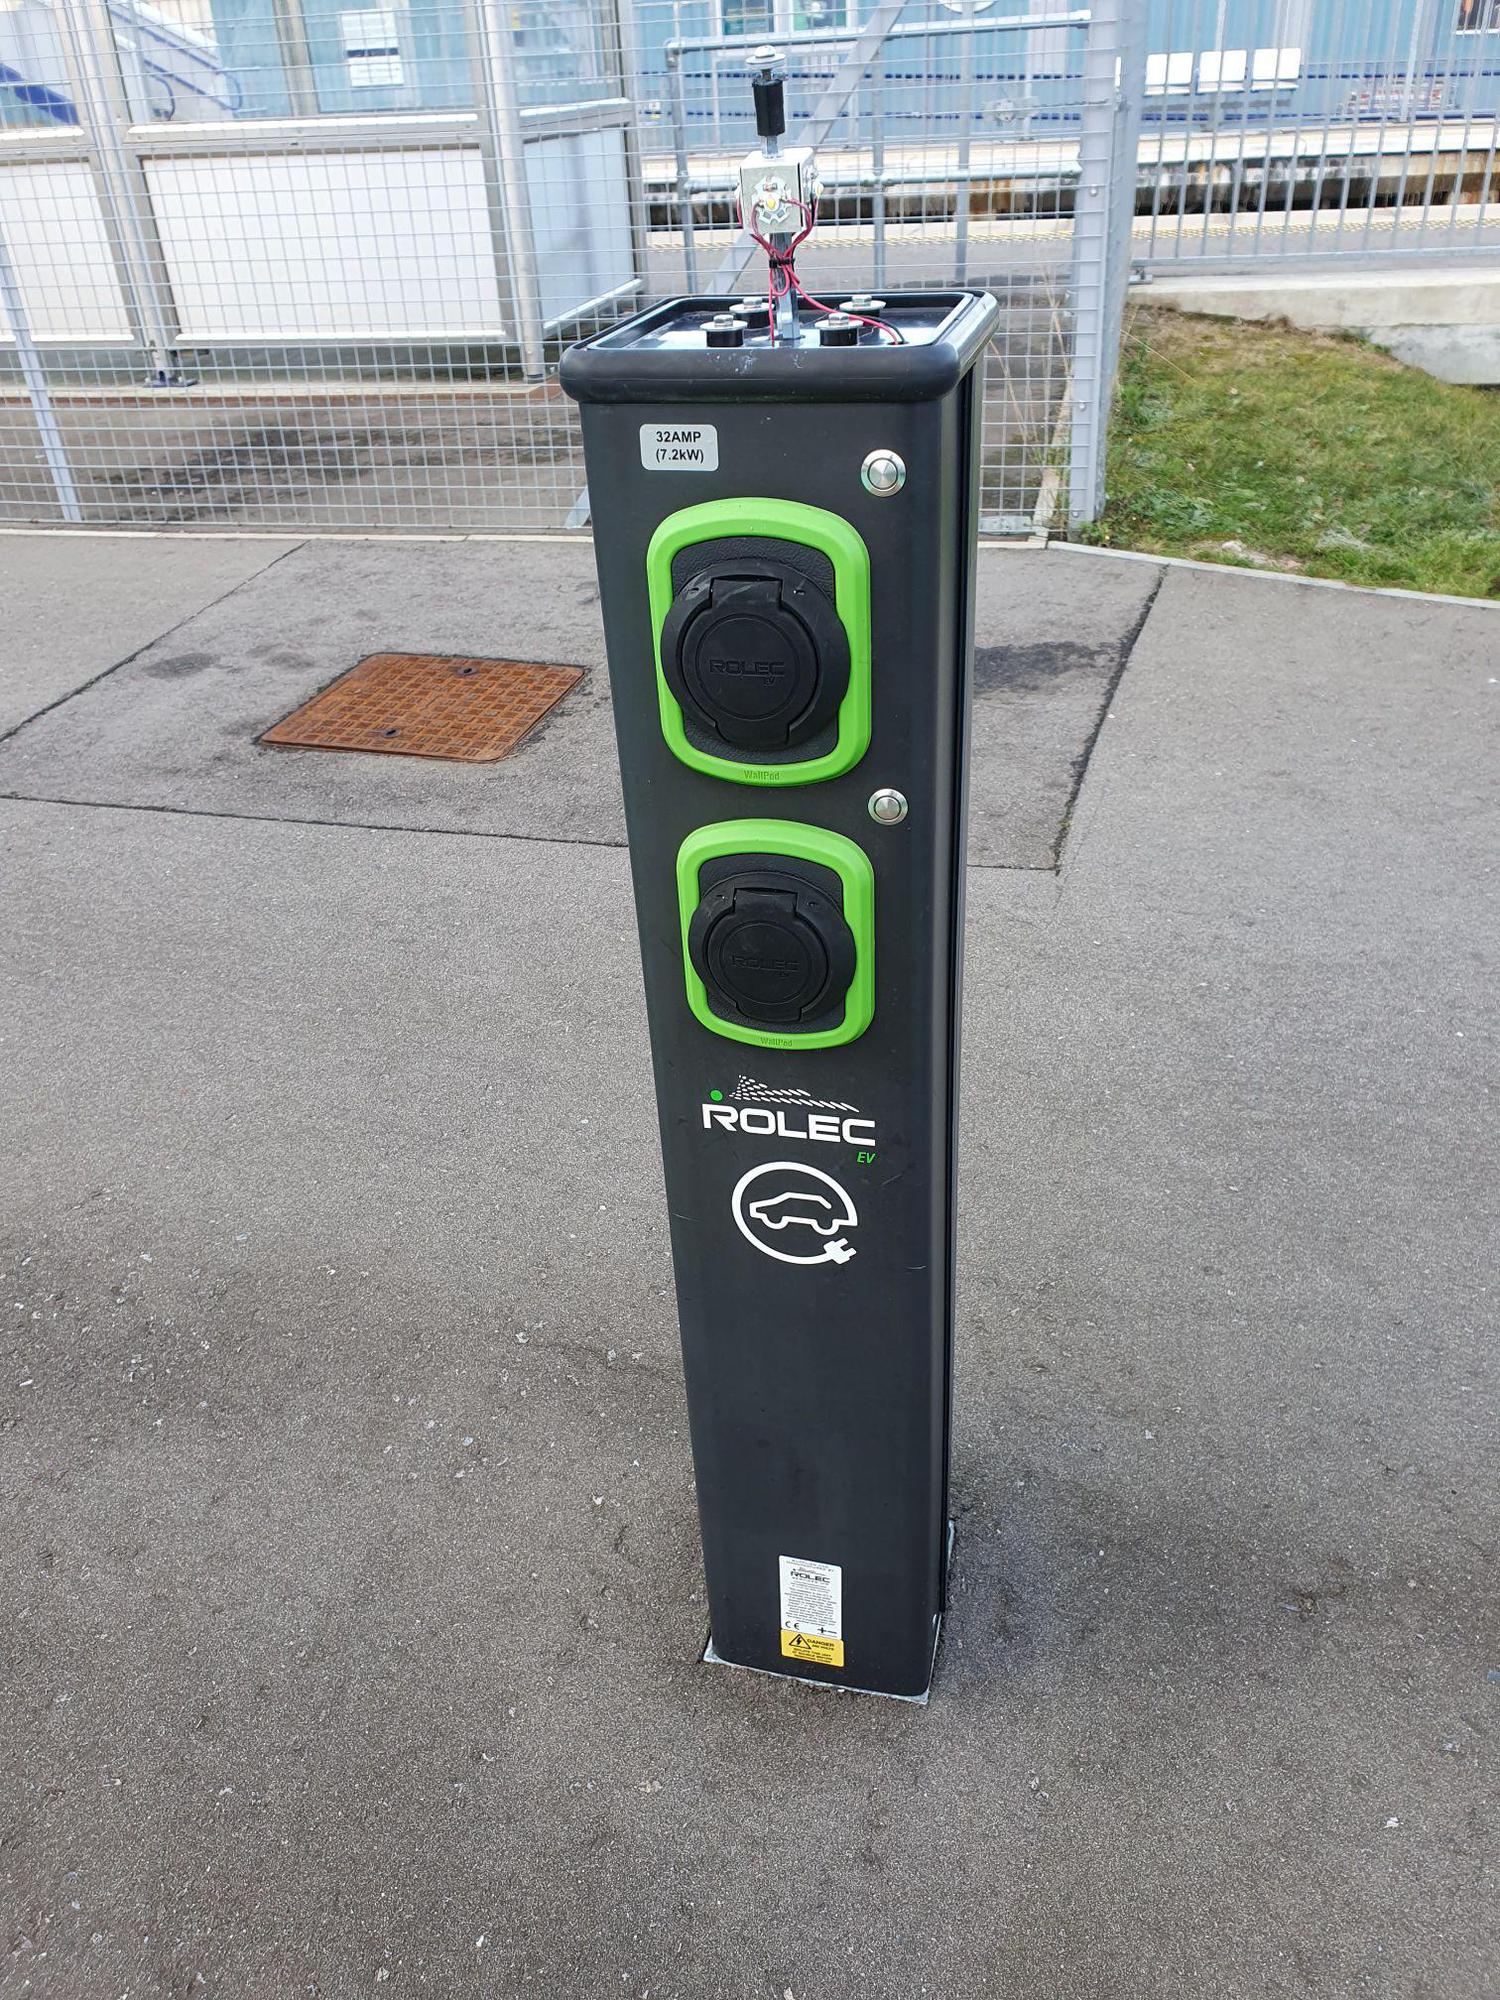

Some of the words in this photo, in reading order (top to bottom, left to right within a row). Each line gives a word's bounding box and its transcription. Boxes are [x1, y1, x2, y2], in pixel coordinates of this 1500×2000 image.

[656, 431, 702, 443] 32AMP
[656, 449, 704, 464] (7.2kW)
[709, 659, 785, 677] ROLEC
[743, 770, 780, 780] WallPod
[760, 1037, 793, 1047] WallPod
[701, 1103, 876, 1147] ROLEC
[856, 1151, 876, 1164] EV
[790, 1571, 831, 1584] ROLEC
